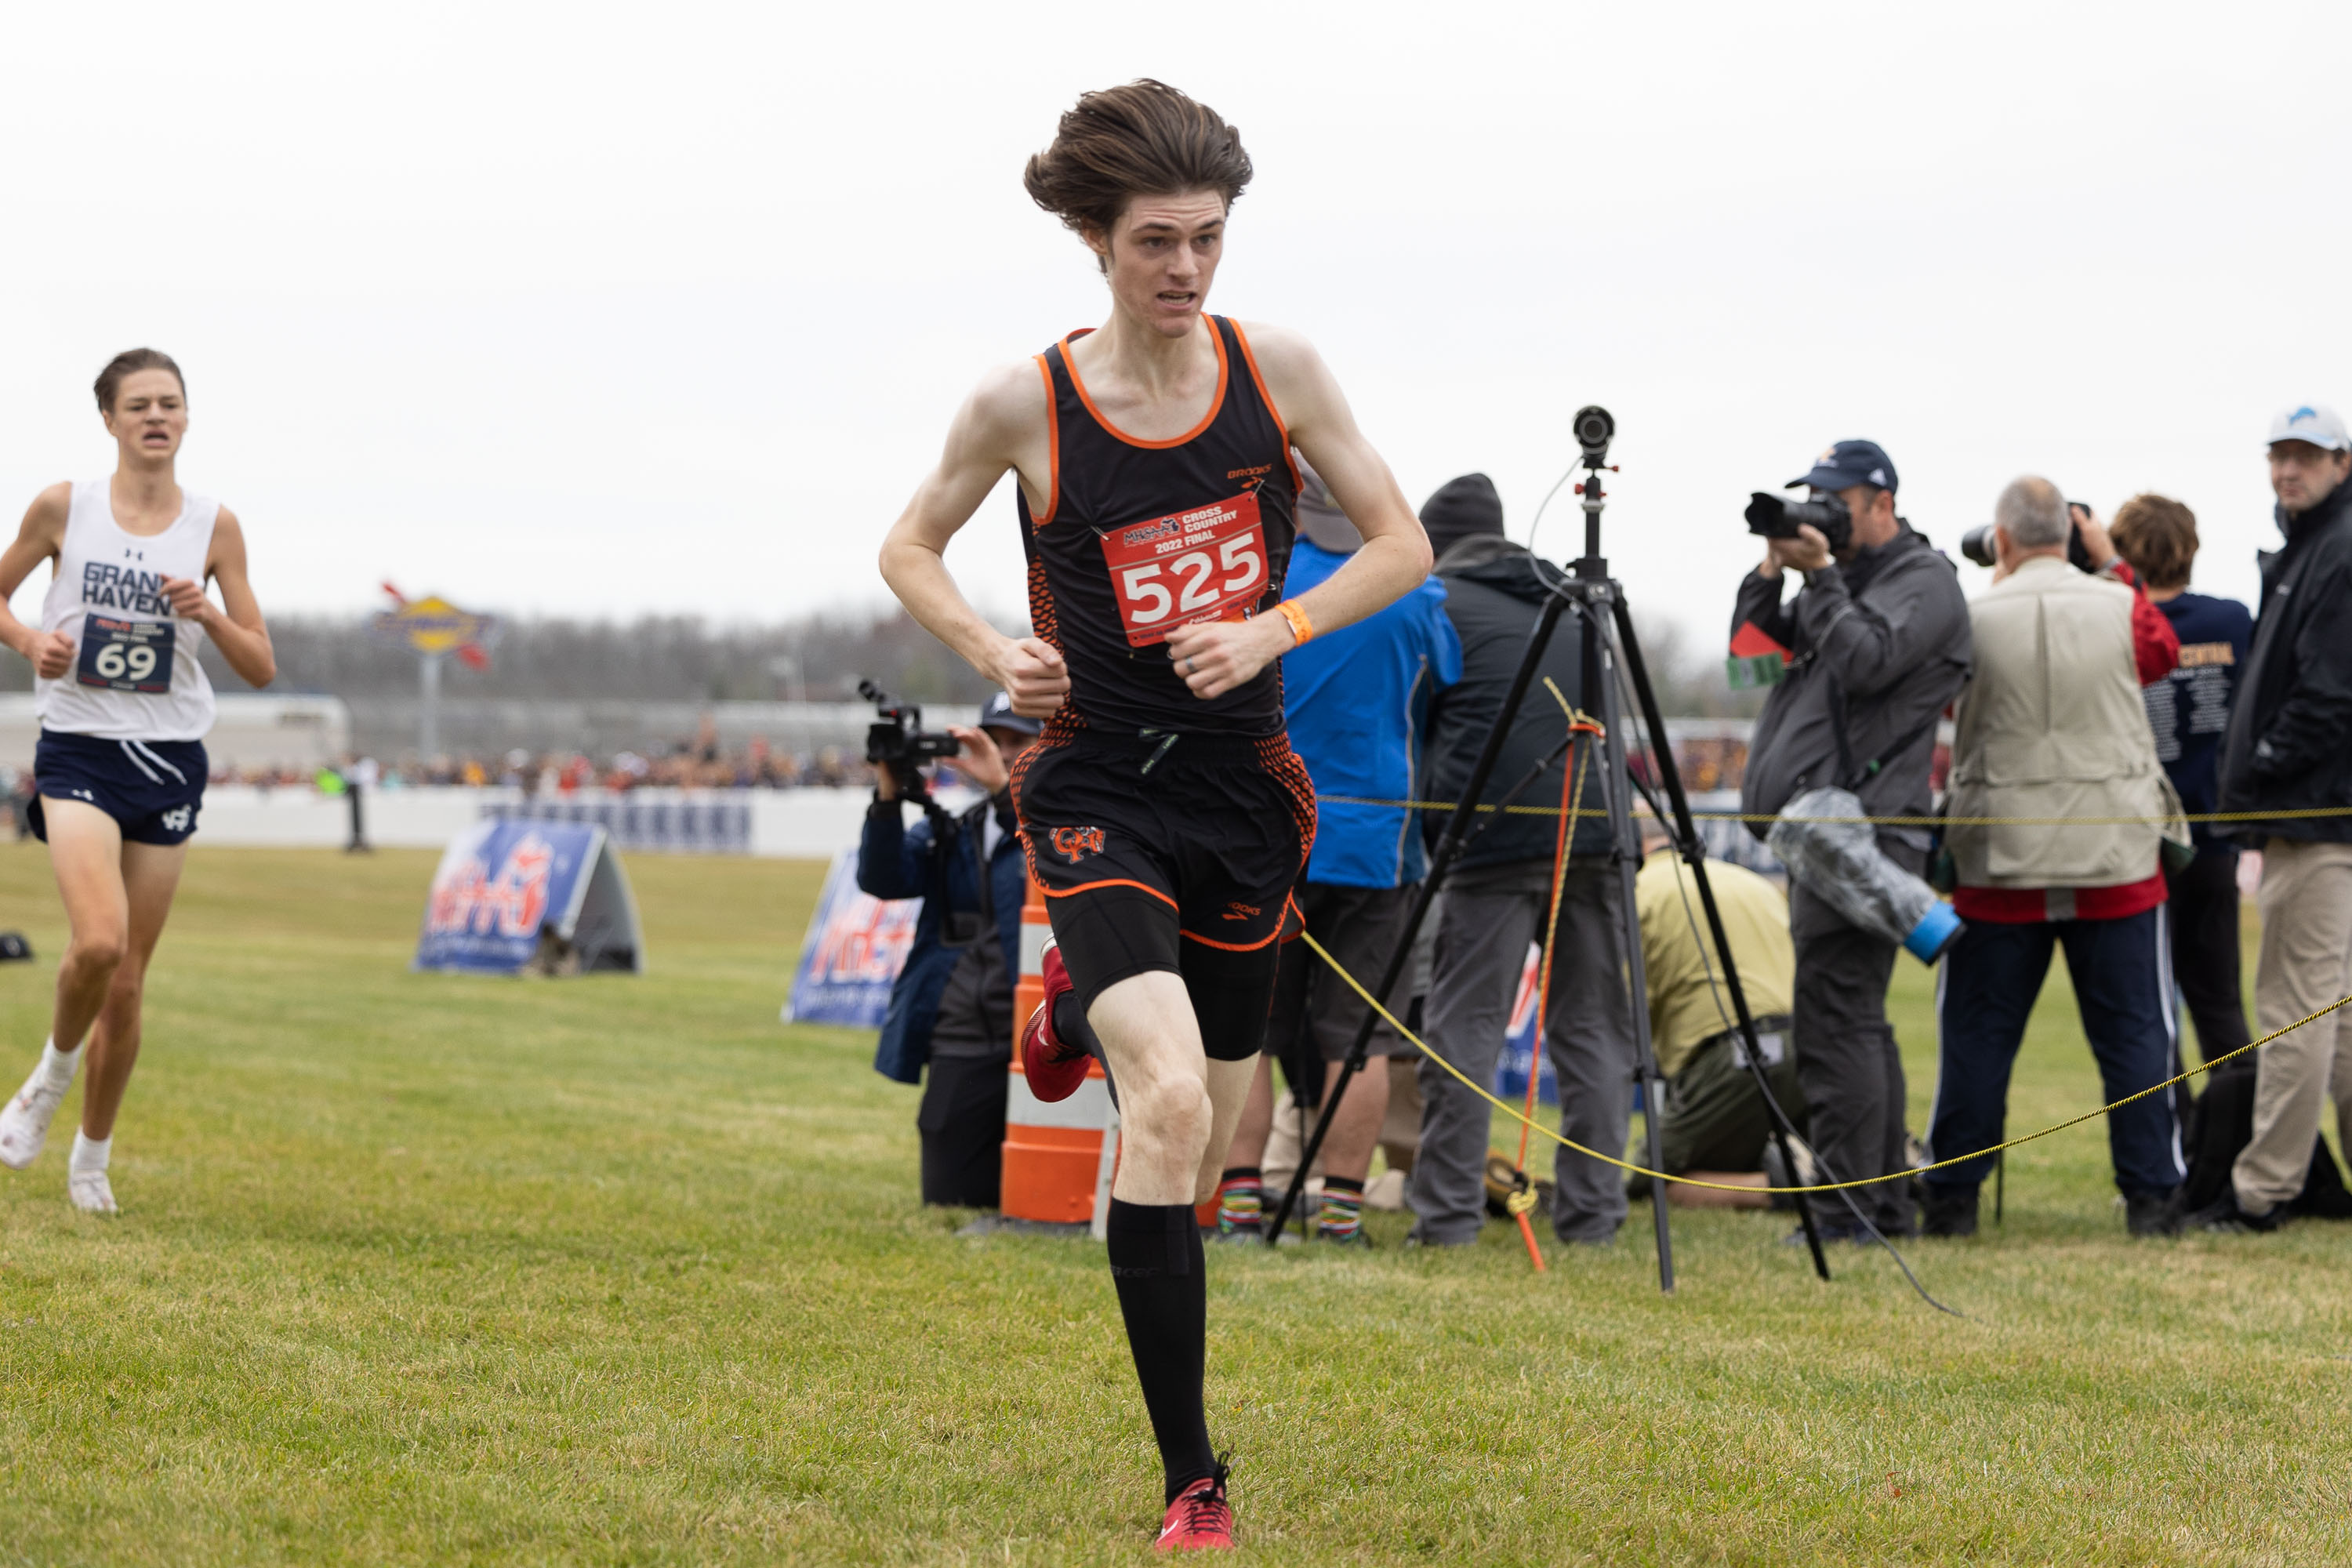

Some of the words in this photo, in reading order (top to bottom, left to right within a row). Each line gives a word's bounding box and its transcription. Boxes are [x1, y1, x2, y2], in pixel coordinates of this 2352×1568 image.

[1227, 464, 1272, 479] BROOKS
[1182, 506, 1222, 524] CROSS
[1184, 510, 1237, 533] COUNTRY
[1155, 539, 1183, 554] 2022
[1185, 530, 1216, 546] FINAL
[1122, 532, 1261, 624] 525
[82, 582, 172, 616] HAVEN
[96, 643, 157, 681] 69
